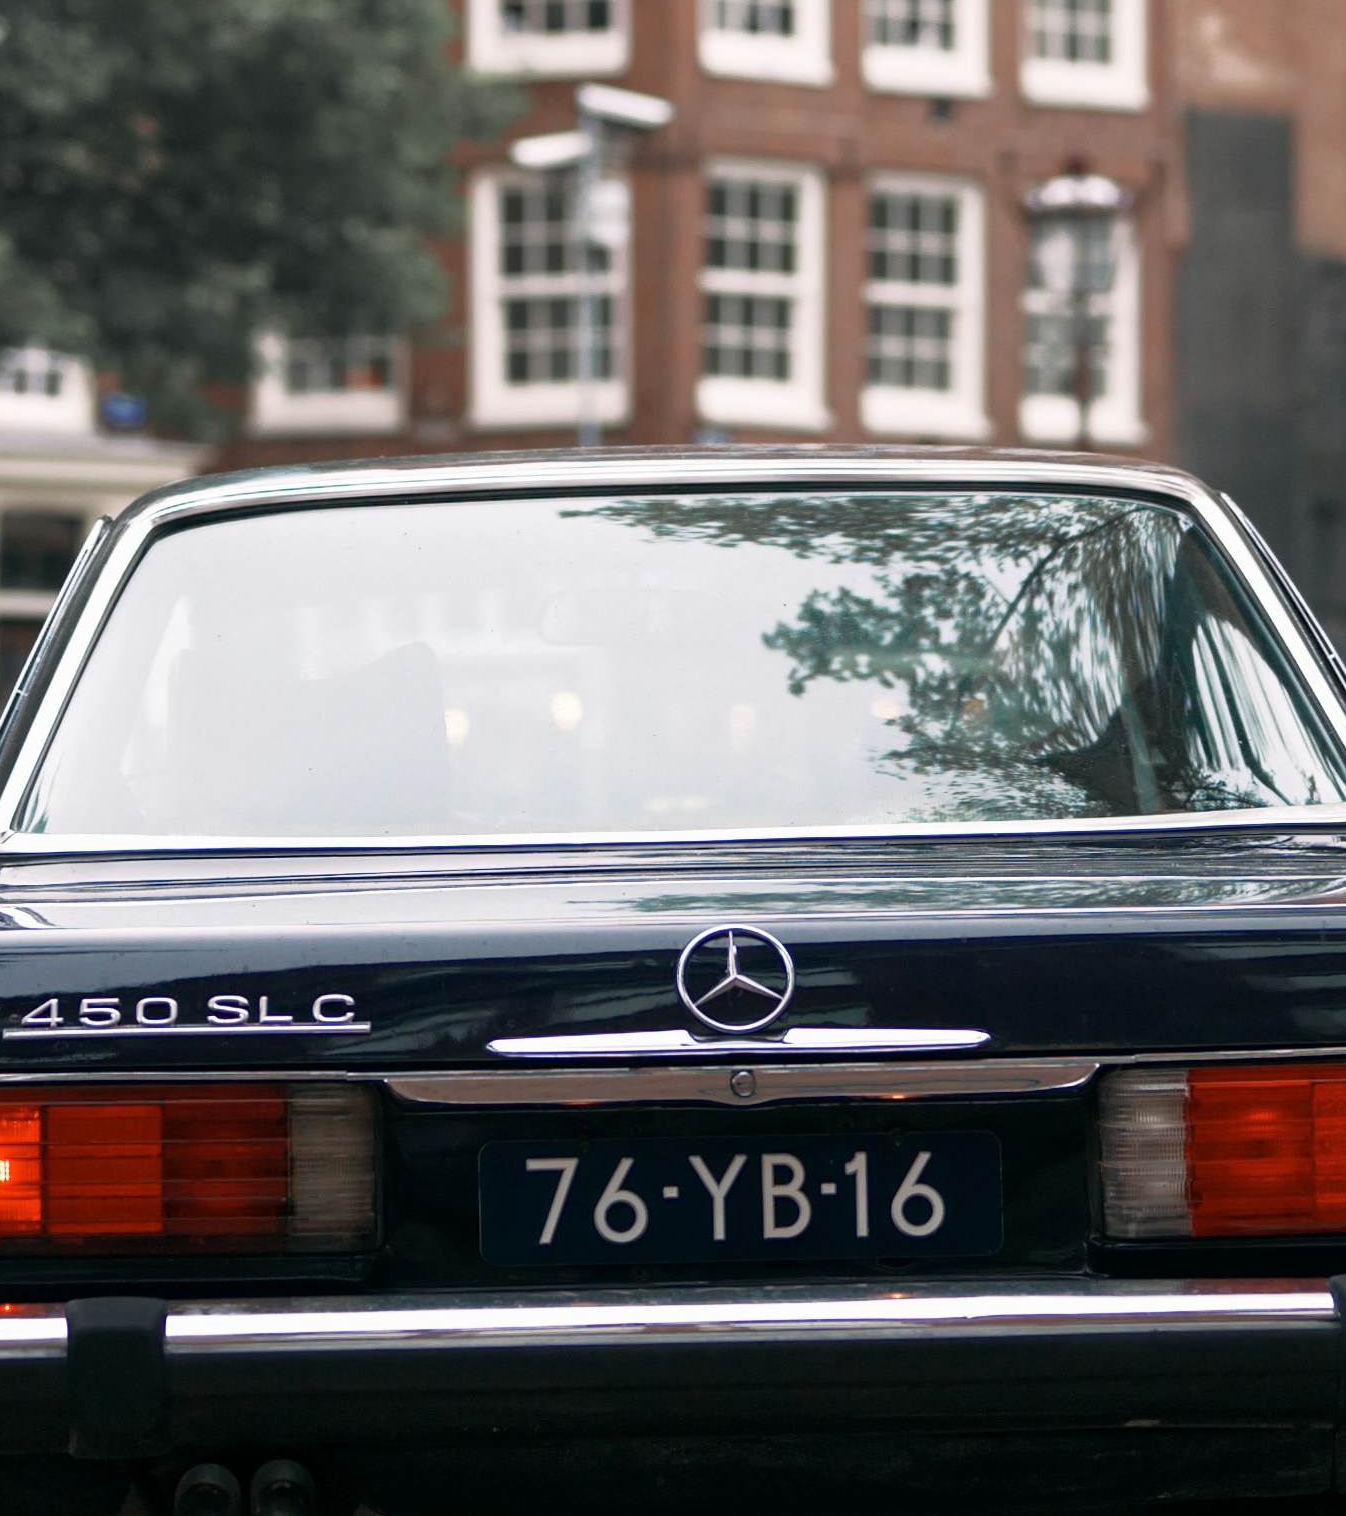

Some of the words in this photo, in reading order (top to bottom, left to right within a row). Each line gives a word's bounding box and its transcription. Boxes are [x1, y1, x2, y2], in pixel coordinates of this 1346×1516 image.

[20, 996, 179, 1028] 450
[206, 993, 356, 1025] SLC
[525, 1150, 946, 1245] 76-YB-16
